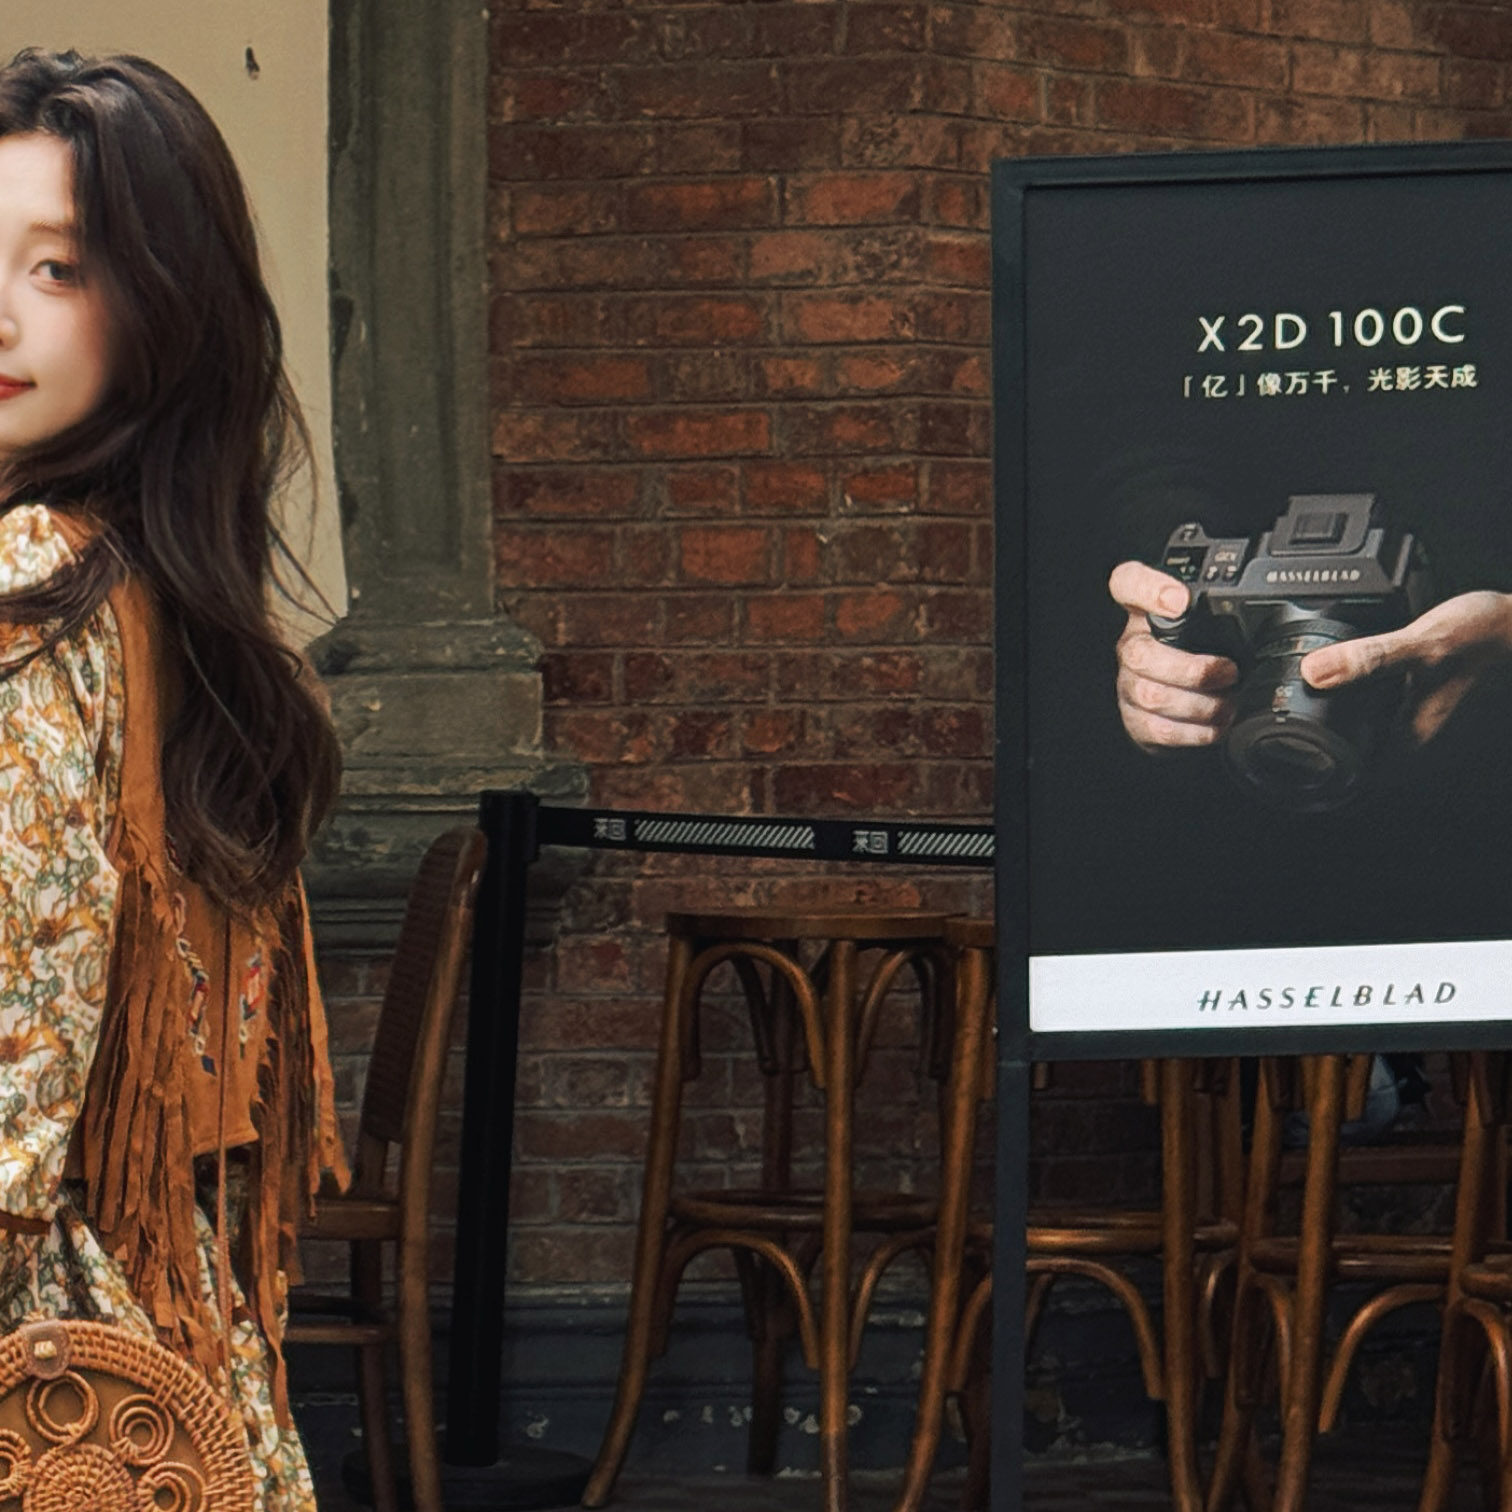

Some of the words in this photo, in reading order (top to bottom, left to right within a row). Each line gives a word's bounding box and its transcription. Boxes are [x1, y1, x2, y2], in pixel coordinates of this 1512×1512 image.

[1197, 313, 1307, 352] X2D
[1329, 305, 1465, 347] 100C
[1197, 982, 1457, 1011] HASSELBLAD
